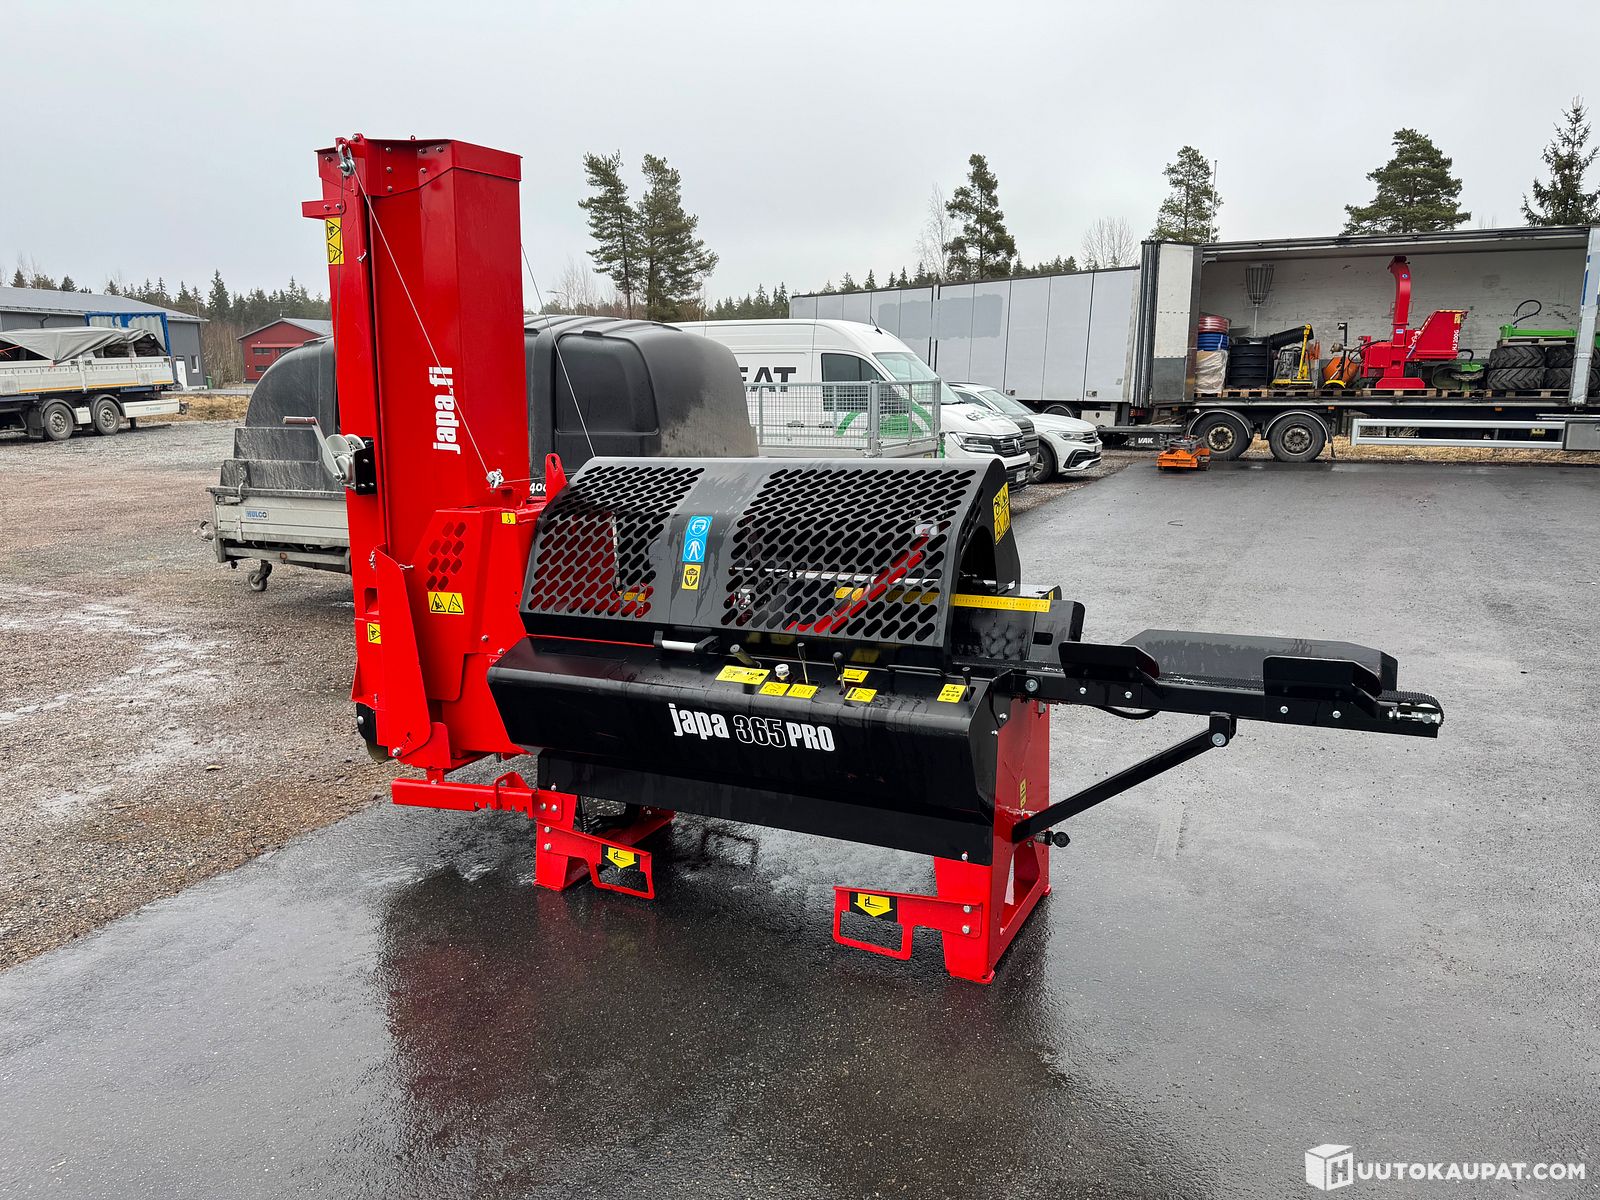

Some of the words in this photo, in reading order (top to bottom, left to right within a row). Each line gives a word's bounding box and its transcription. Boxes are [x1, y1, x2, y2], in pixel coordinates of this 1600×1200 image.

[428, 366, 462, 455] japa.fi
[668, 703, 730, 740] japa
[733, 714, 787, 748] 365
[786, 721, 835, 752] PRO
